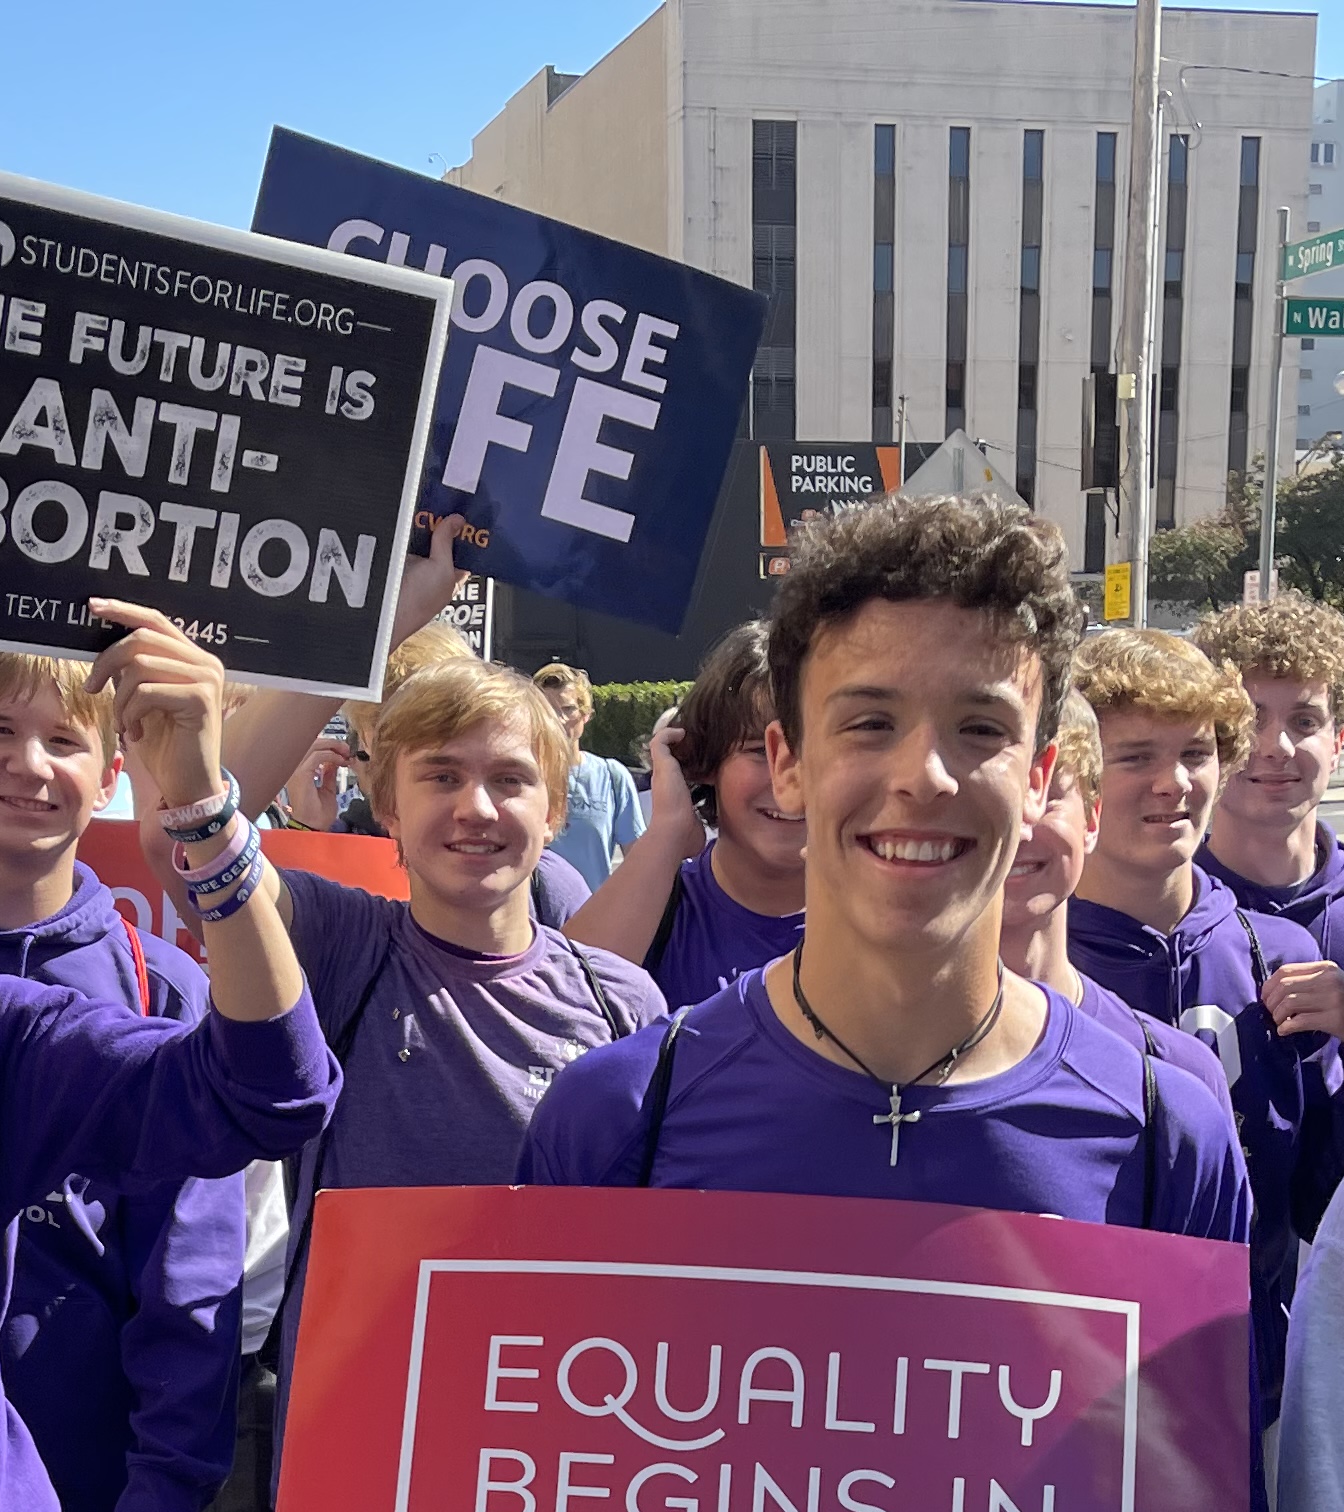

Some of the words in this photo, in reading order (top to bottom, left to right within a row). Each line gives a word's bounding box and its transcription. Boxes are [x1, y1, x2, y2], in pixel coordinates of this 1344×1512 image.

[1297, 239, 1334, 273] Spring
[1338, 239, 1344, 252] St
[20, 235, 356, 337] STUDENTSFORLIFE.ORG
[1293, 312, 1301, 324] N
[68, 311, 308, 409] FUTURE
[324, 365, 377, 421] IS
[441, 343, 662, 544] FE
[791, 455, 856, 473] PUBLIC
[791, 476, 873, 493] PARKING
[6, 593, 61, 621] TEXT
[173, 617, 228, 645] 3445
[482, 1333, 1064, 1453] EQUALITY
